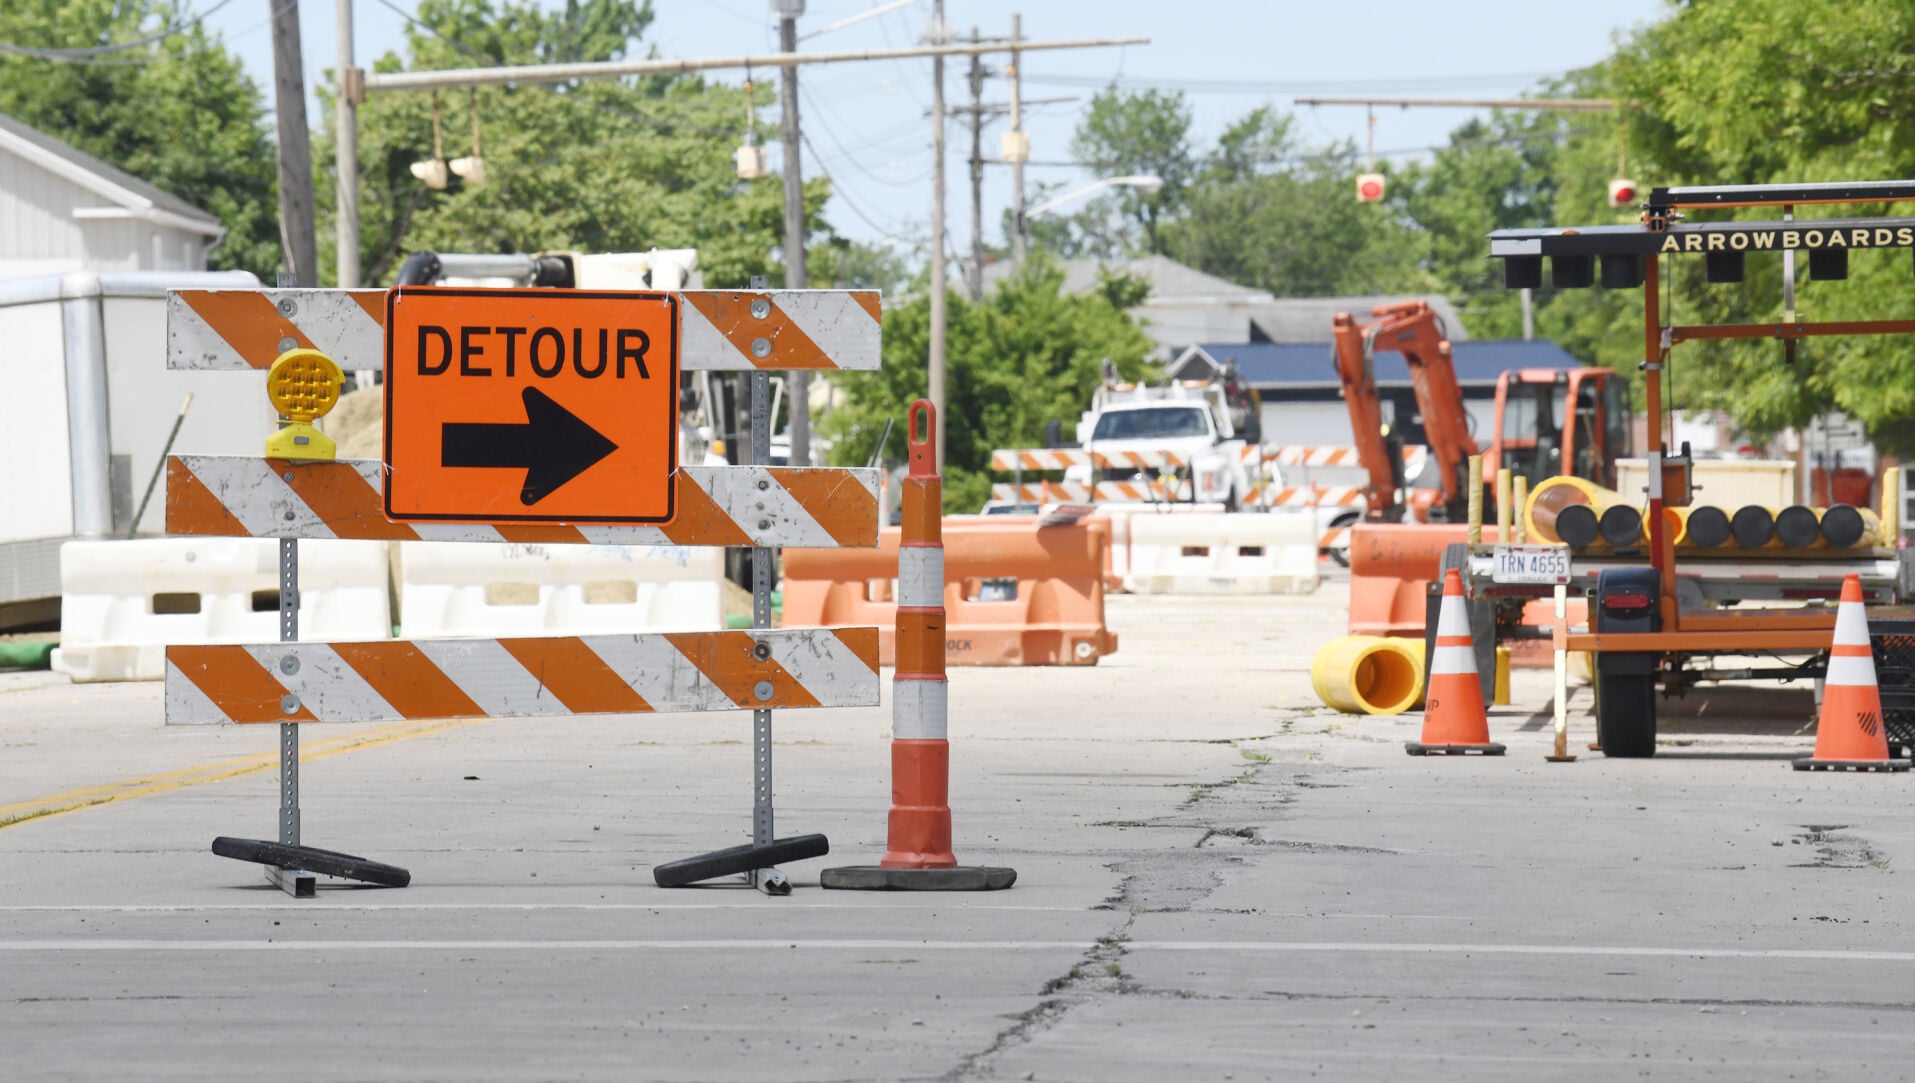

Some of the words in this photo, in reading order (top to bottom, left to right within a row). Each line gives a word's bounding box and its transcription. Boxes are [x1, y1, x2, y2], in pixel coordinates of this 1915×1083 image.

[417, 325, 650, 379] DETOUR
[1500, 555, 1525, 573] TRN
[1530, 556, 1565, 574] 4655
[946, 639, 972, 651] OCK
